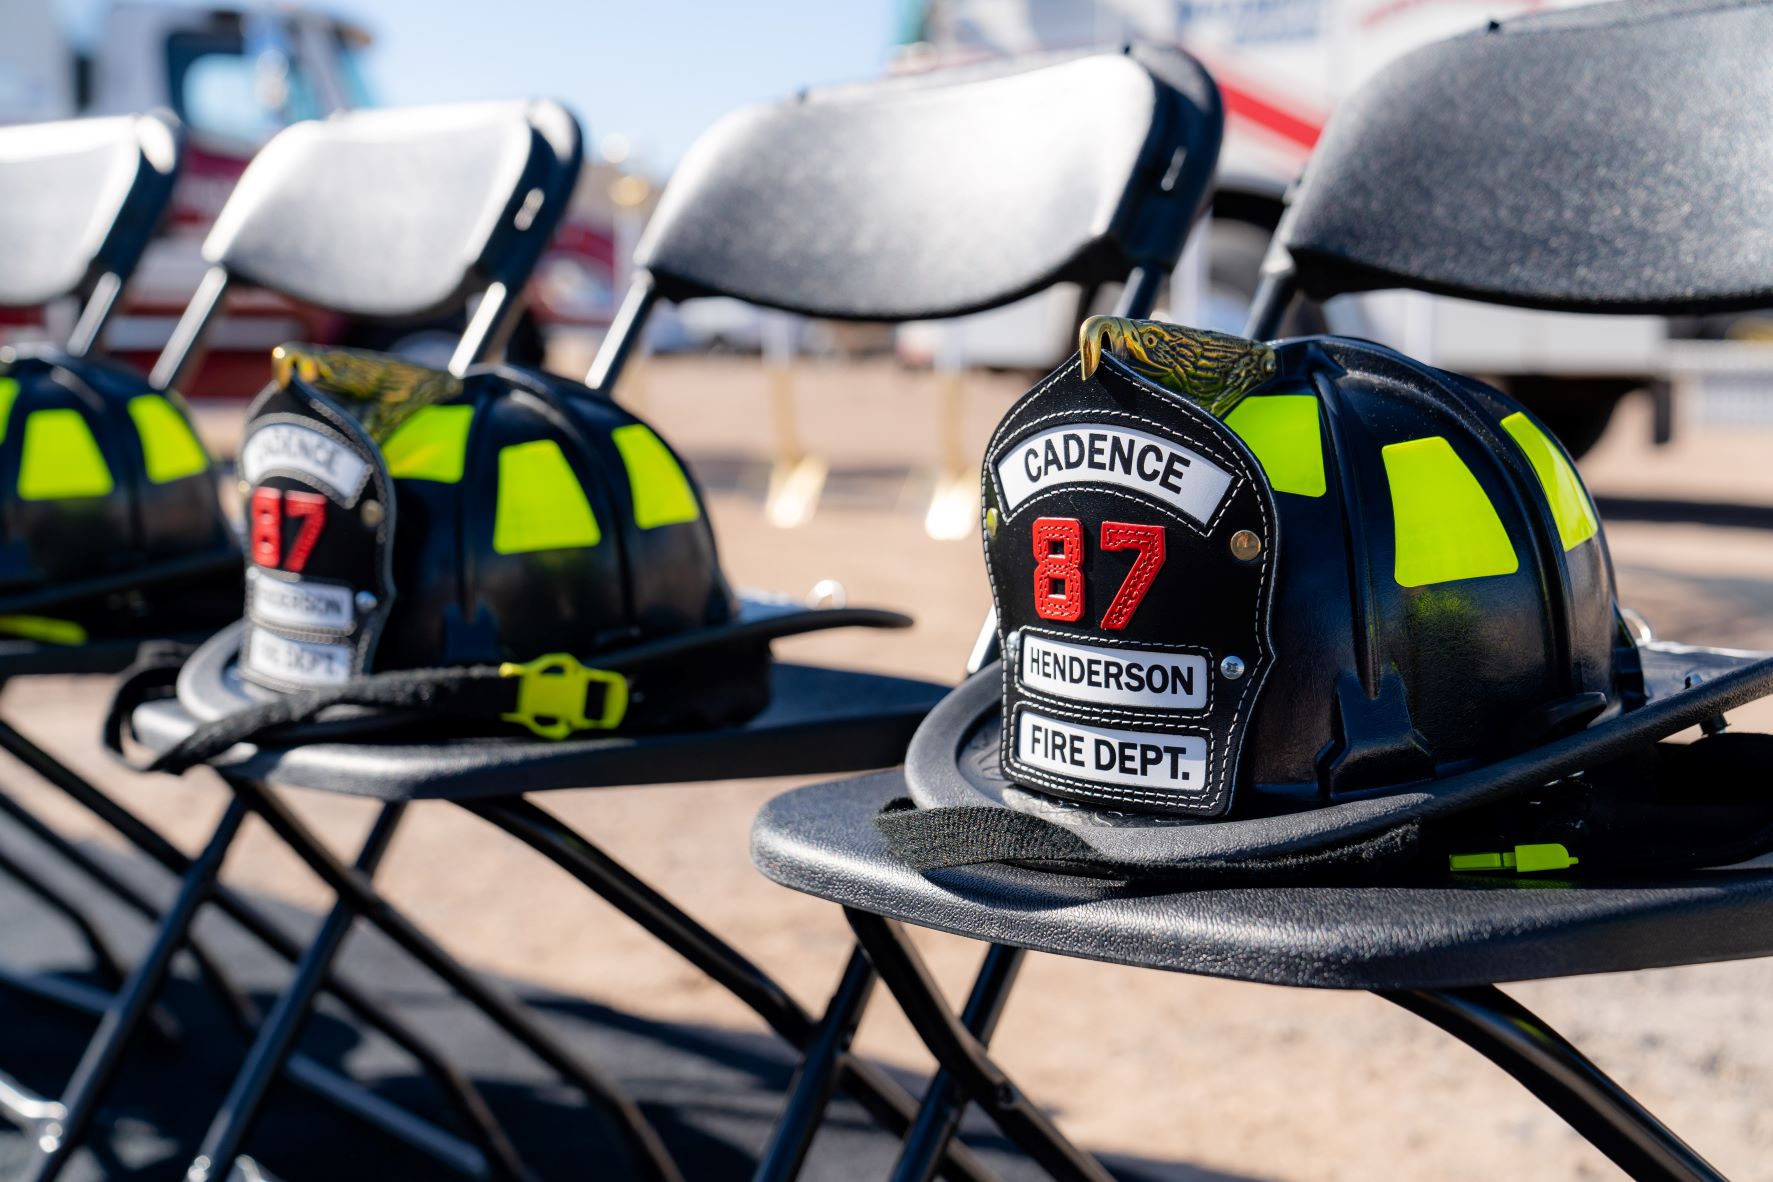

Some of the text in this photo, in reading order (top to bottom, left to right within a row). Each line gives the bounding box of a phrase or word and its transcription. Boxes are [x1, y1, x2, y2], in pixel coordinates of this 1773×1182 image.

[1024, 433, 1191, 494] CADENCE
[252, 486, 328, 573] 87
[1032, 516, 1167, 631] 87
[1030, 646, 1195, 696] HENDERSON
[1031, 724, 1191, 781] FIRE DEPT.
